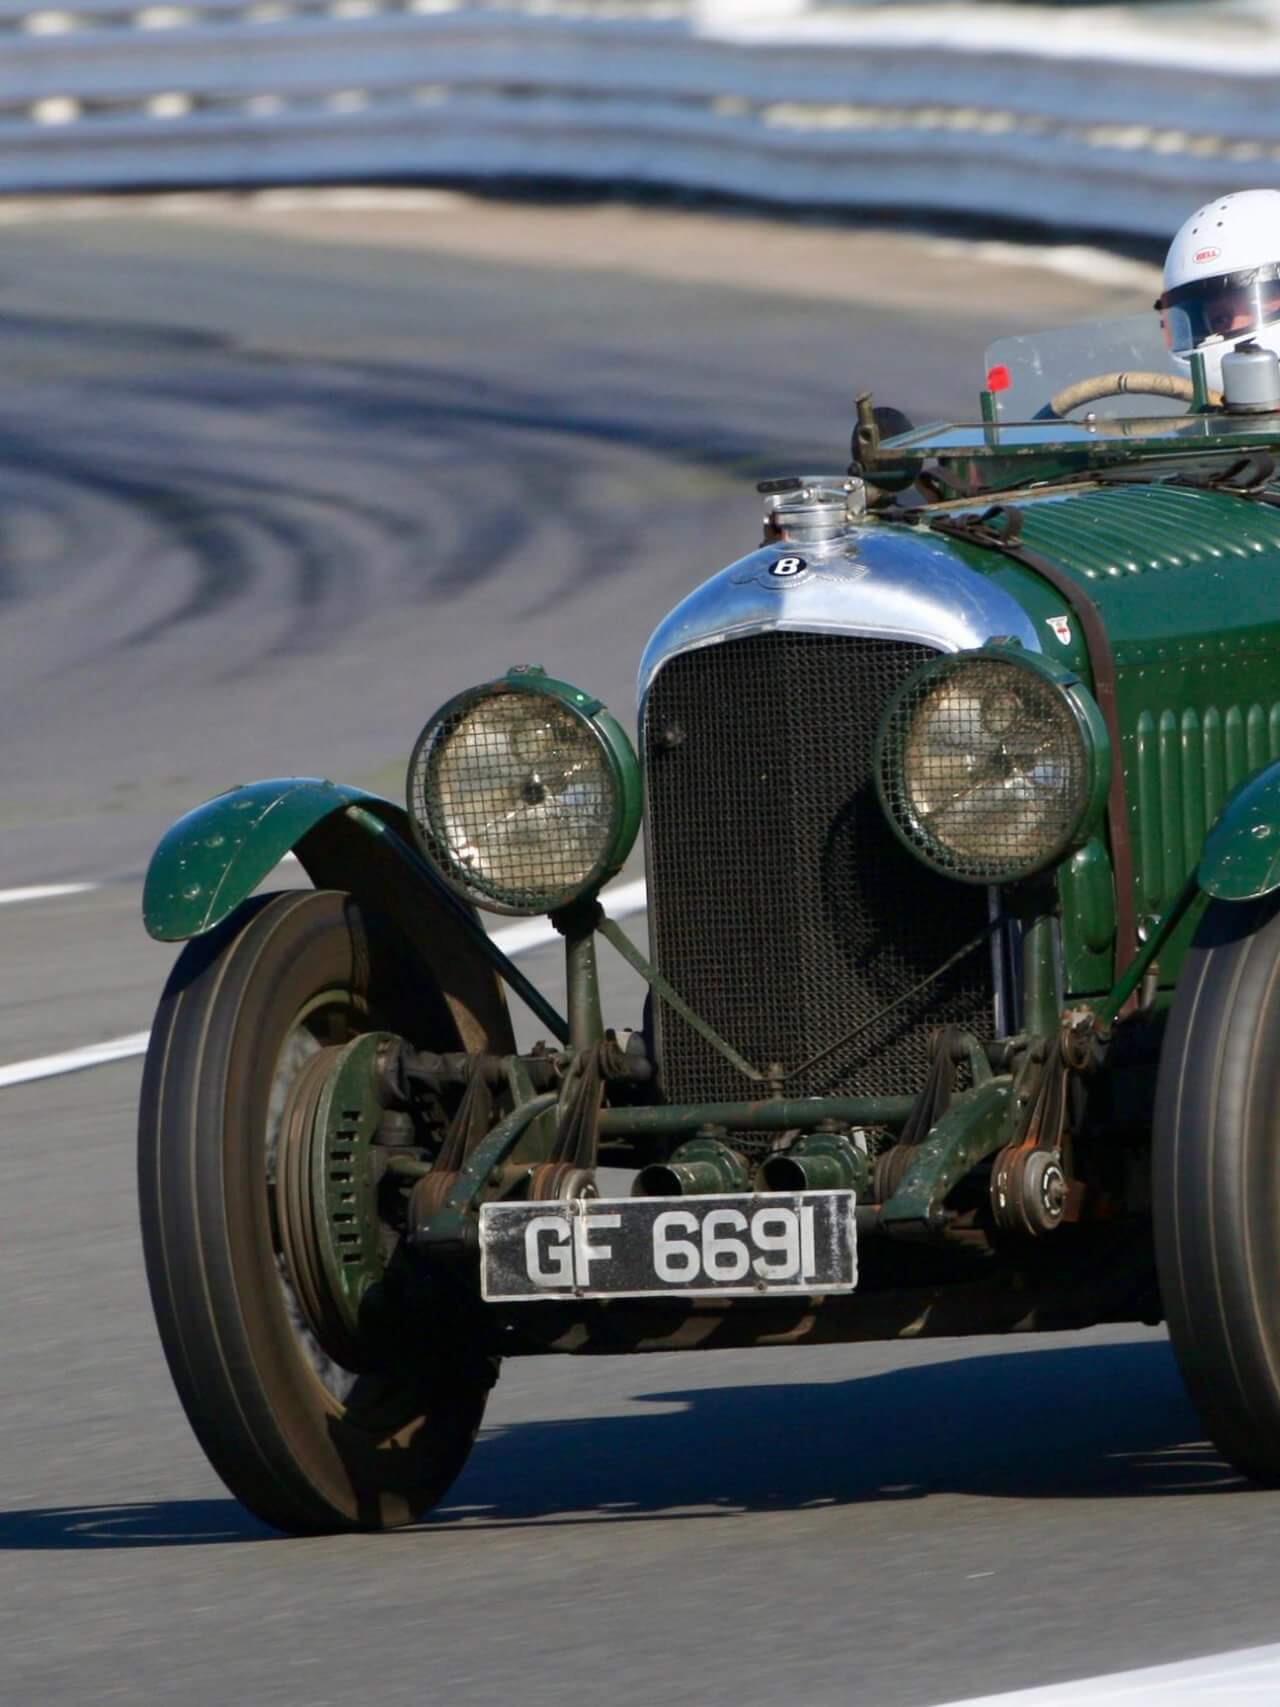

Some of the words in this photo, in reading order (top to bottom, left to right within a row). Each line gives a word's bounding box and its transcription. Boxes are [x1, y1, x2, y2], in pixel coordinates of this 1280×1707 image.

[1195, 250, 1217, 261] BELL
[774, 557, 800, 574] B
[525, 1214, 621, 1287] GF
[652, 1206, 816, 1283] 6691
